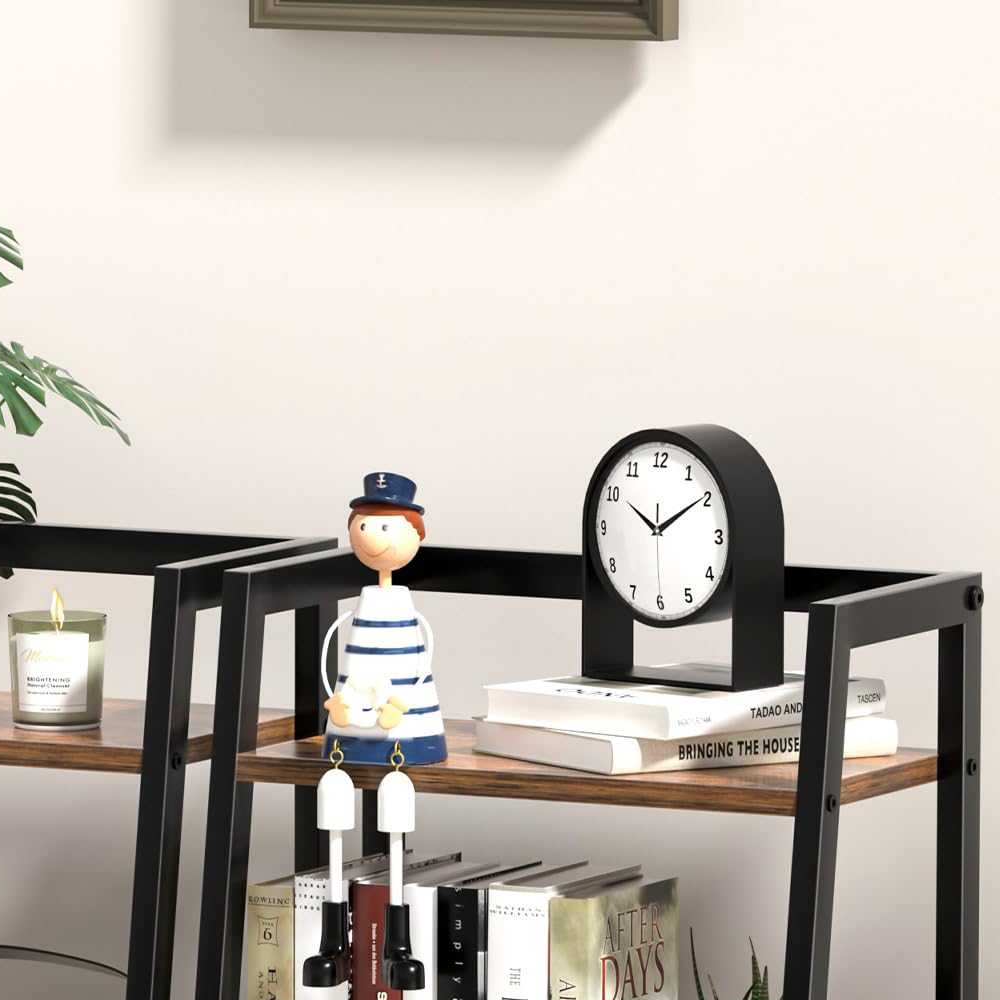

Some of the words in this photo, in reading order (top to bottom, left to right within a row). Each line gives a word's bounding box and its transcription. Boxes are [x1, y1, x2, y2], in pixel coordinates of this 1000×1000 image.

[652, 452, 669, 469] 12
[626, 461, 640, 478] 11
[684, 465, 693, 481] 1
[606, 486, 620, 502] 10
[703, 491, 712, 507] 2
[600, 519, 607, 536] 9
[714, 529, 724, 545] 3
[609, 557, 617, 573] 8
[705, 566, 715, 581] 4
[629, 584, 637, 600] 7
[684, 587, 693, 603] 5
[656, 594, 665, 611] 6
[750, 704, 782, 719] TADAO
[678, 741, 734, 760] BRINGING
[737, 739, 759, 756] THE
[762, 737, 800, 754] HOUSE
[248, 895, 291, 904] ROWLING
[263, 927, 272, 941] 6
[603, 903, 664, 955] AFTER
[509, 967, 522, 986] THE
